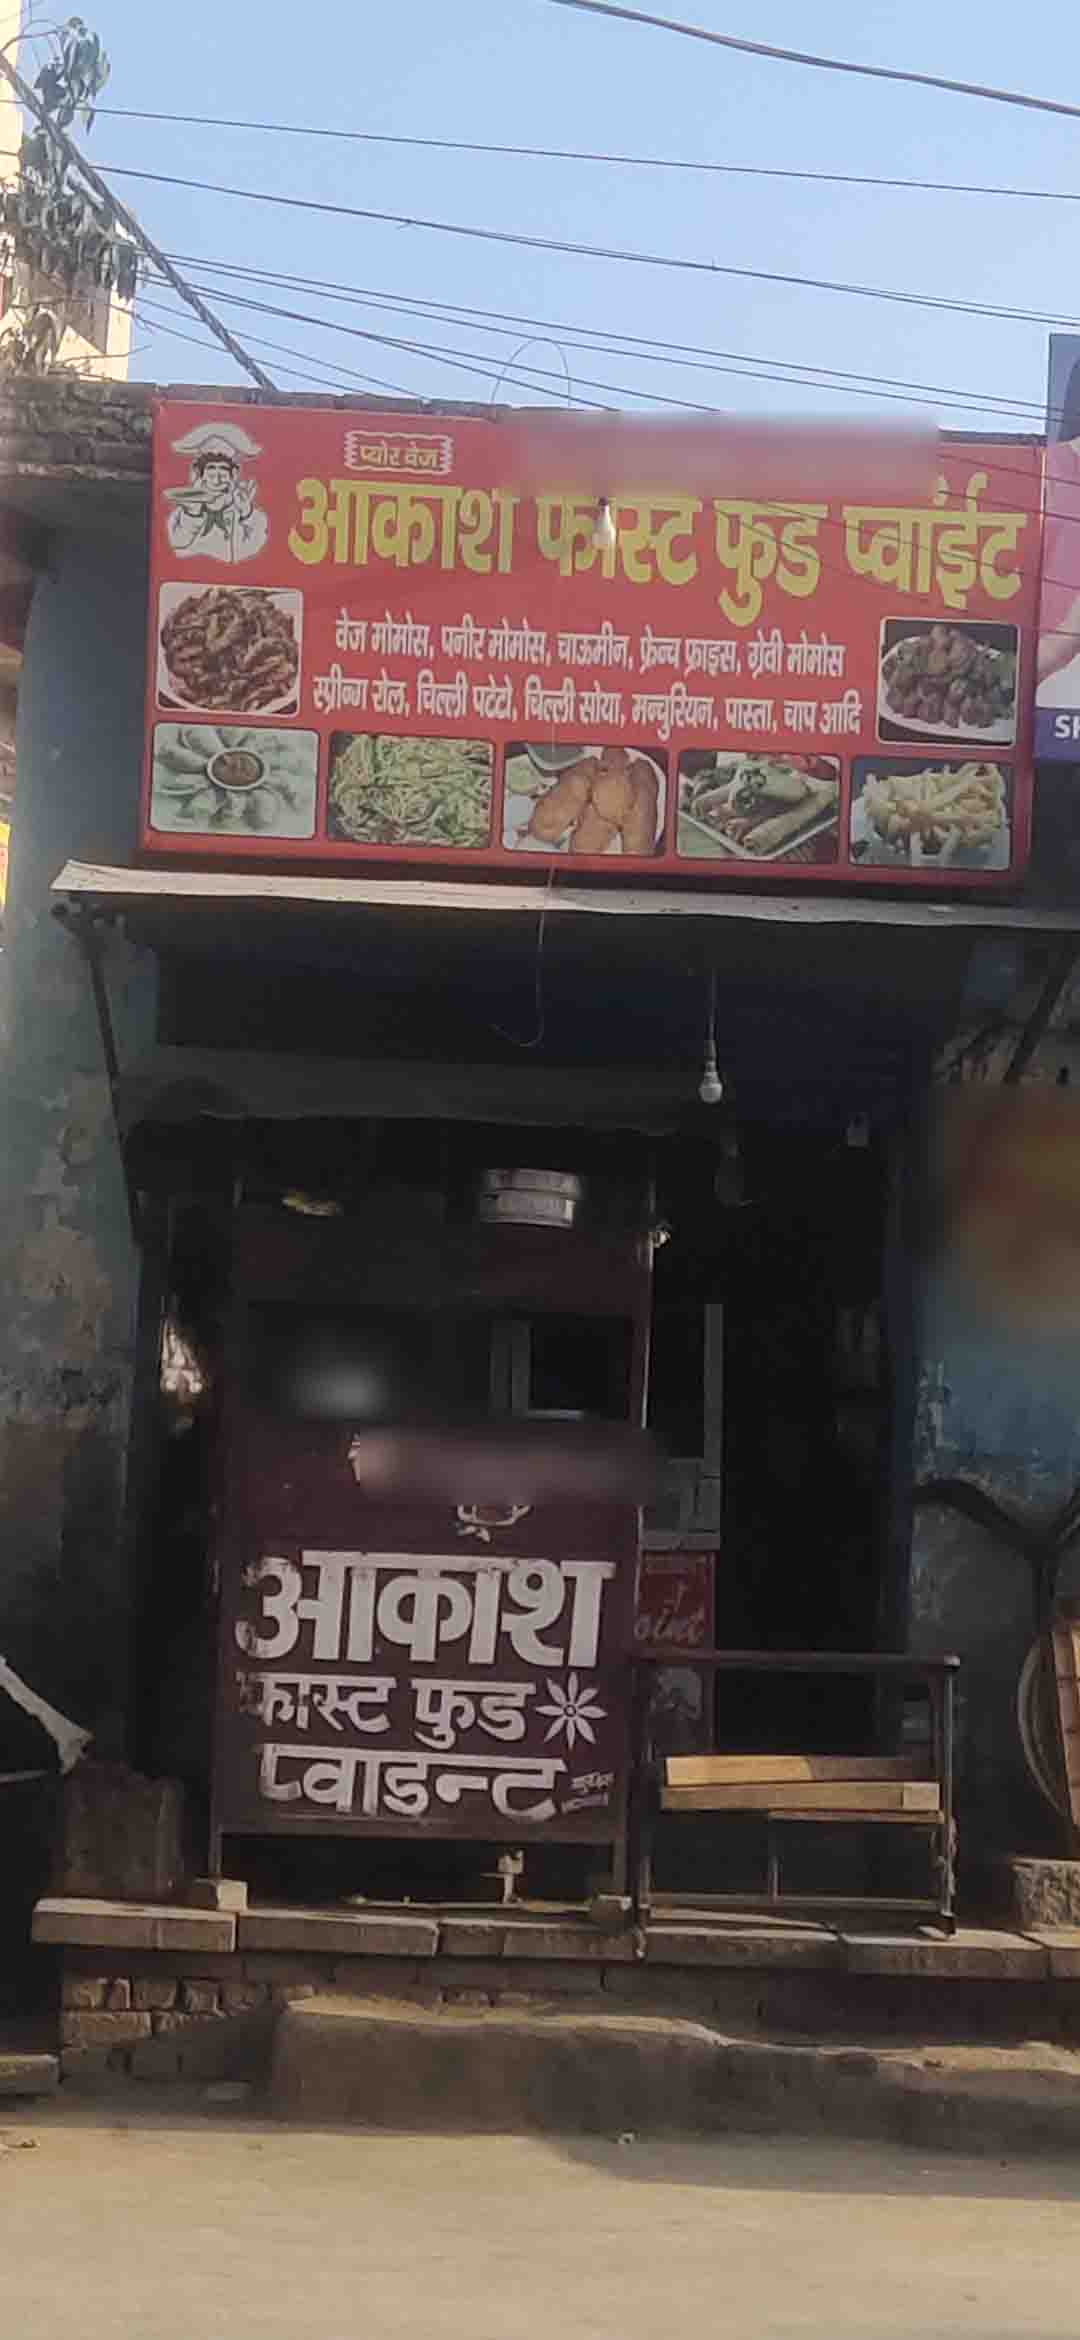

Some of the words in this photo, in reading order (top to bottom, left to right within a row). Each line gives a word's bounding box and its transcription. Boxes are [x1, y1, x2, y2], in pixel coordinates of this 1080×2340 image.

[405, 440, 438, 467] वेज
[287, 477, 519, 575] आकाश
[535, 494, 703, 585] फास्ट
[712, 498, 829, 627] फुड
[335, 608, 368, 651] वेज
[371, 610, 435, 660] मोमोस,
[441, 613, 488, 661] पनीर
[488, 616, 552, 667] मोमोस,
[747, 627, 784, 680] ग्रेवी
[786, 630, 847, 679] मोमोस
[371, 666, 410, 718] रोल,
[416, 668, 468, 719] चिल्ली
[524, 673, 576, 724] चिल्ली
[578, 679, 626, 729] सोया,
[724, 697, 777, 735] पास्ता,
[783, 699, 817, 733] चाप
[818, 688, 863, 735] आदि
[234, 1549, 617, 1669] आकाश
[410, 1677, 537, 1750] फुड
